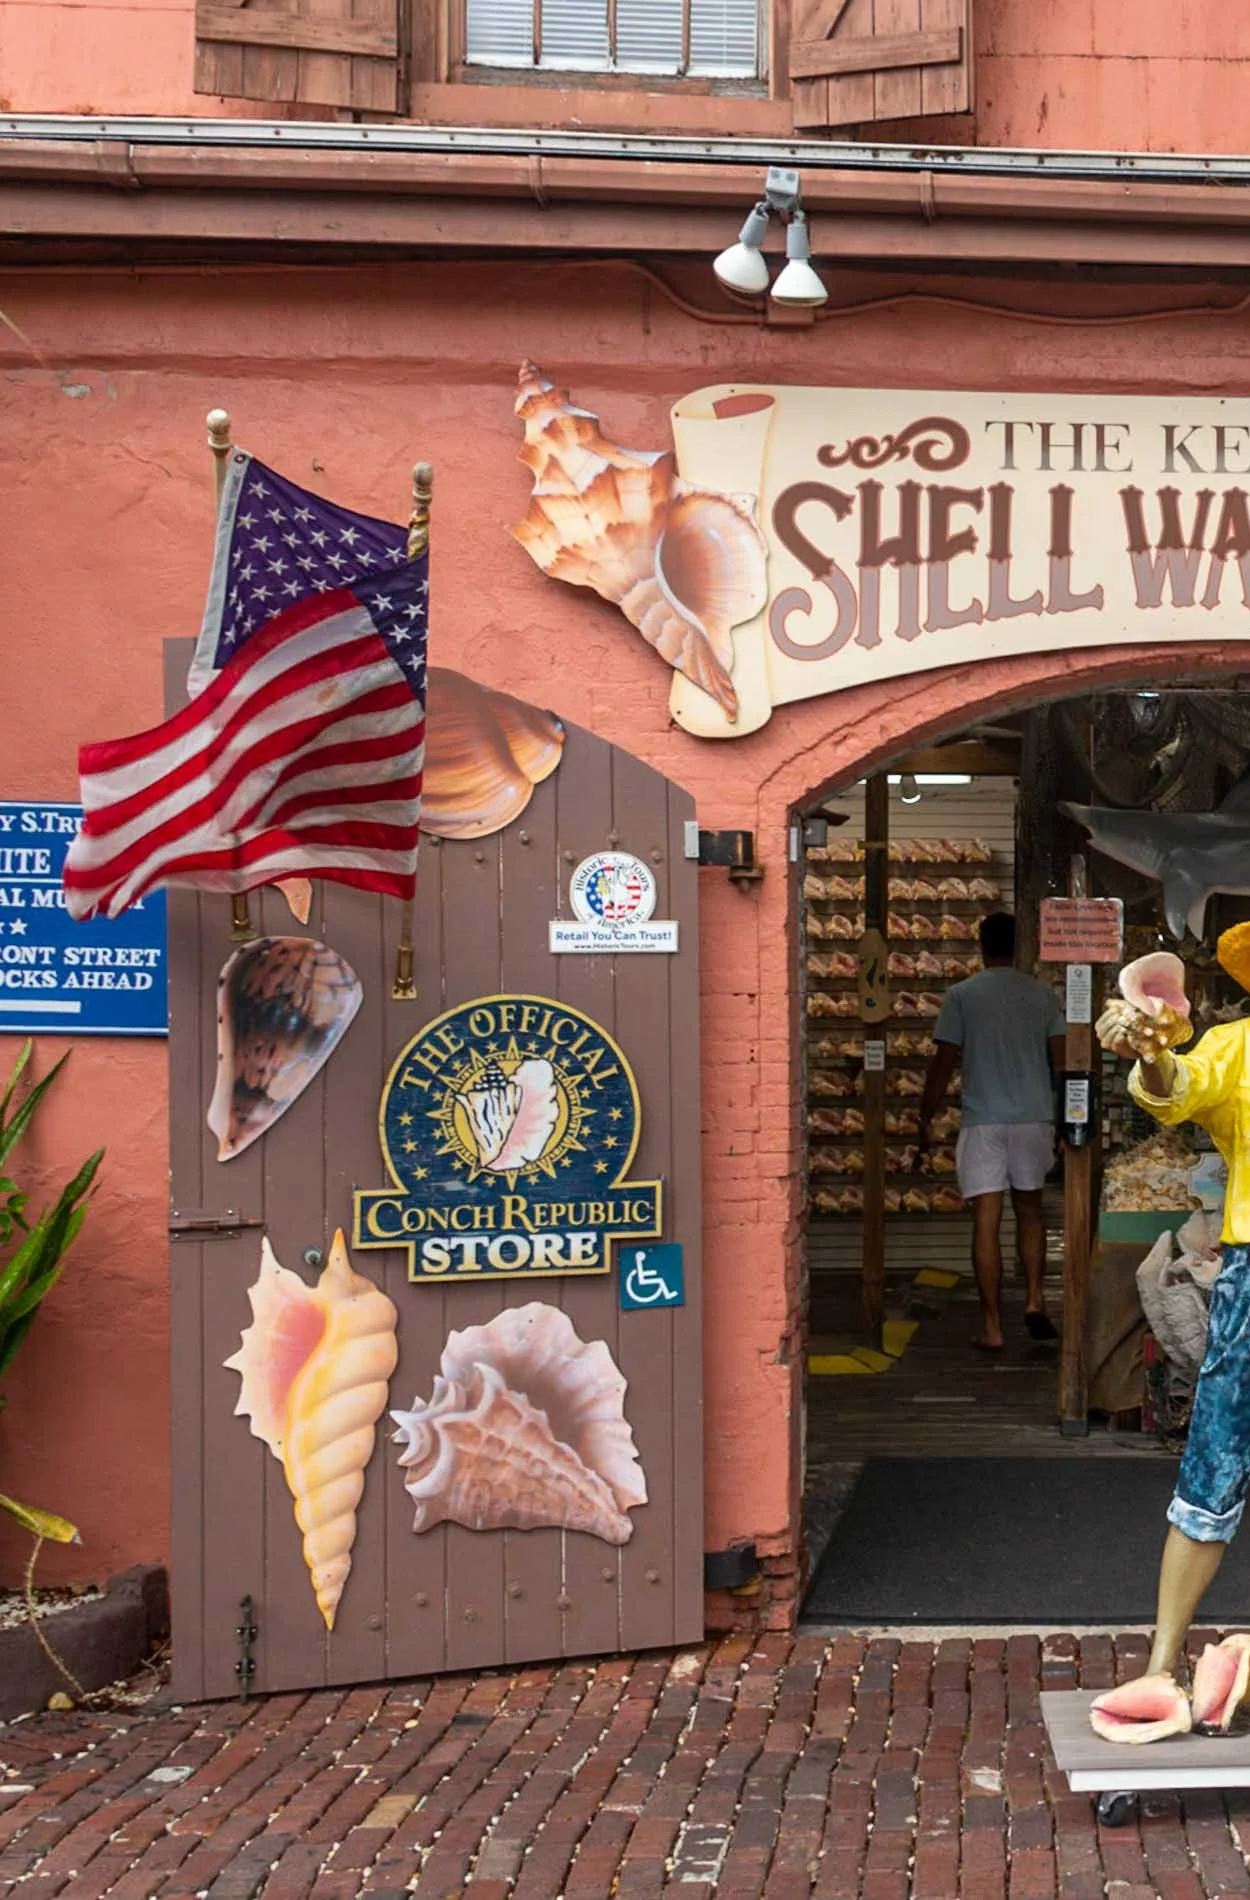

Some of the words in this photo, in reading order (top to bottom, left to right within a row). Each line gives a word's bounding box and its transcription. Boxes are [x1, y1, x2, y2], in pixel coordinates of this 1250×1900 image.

[984, 420, 1134, 473] THE
[768, 478, 1105, 662] SHELL
[0, 848, 51, 874] ITE
[0, 945, 56, 965] ONT
[63, 946, 161, 968] STREET
[555, 930, 589, 941] Retail
[591, 931, 612, 941] You
[613, 930, 637, 941] Can
[639, 930, 672, 941] Trust!
[62, 971, 154, 991] AHEAD
[400, 1024, 465, 1092] THE
[468, 1004, 621, 1091] OFFICIAL
[367, 1199, 496, 1238] CONCH
[501, 1194, 652, 1234] REPUBLIC
[421, 1231, 600, 1274] STORE
